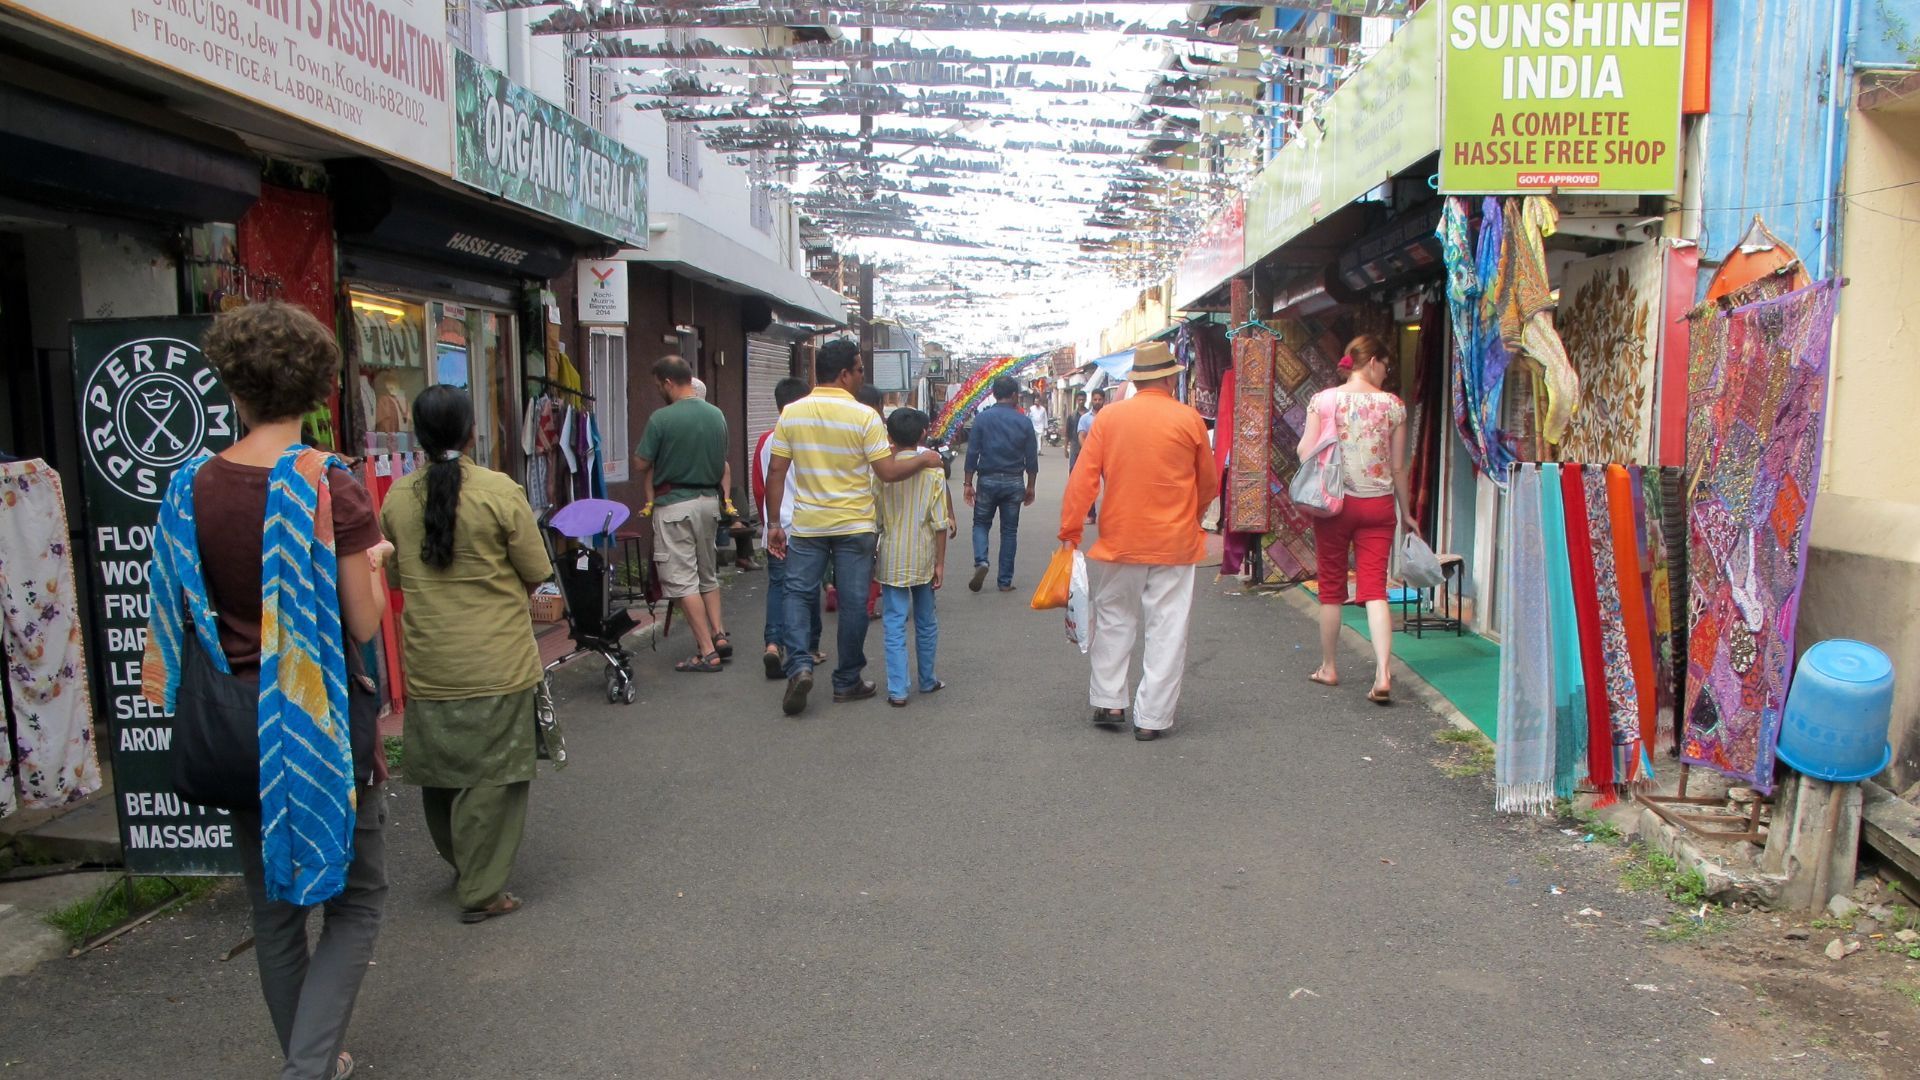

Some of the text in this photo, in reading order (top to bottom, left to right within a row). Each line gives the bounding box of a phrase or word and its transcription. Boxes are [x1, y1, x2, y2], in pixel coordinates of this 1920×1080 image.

[248, 21, 278, 58] Jew
[1450, 1, 1681, 50] SUNSHINE
[327, 0, 445, 102] ASSOCIATION
[203, 40, 260, 81] OFFICE
[263, 66, 271, 85] &
[274, 71, 363, 126] LABORATORY
[1502, 55, 1624, 100] INDIA
[1491, 111, 1630, 137] A COMPLETE
[485, 96, 637, 226] ORGANIC KERALA
[1454, 140, 1666, 166] HASSLE FREE SHOP
[1518, 175, 1598, 185] GOVT. APPROVED
[446, 232, 529, 265] HASSLE FREE
[115, 695, 176, 720] SEE
[130, 825, 234, 849] MASSAGE
